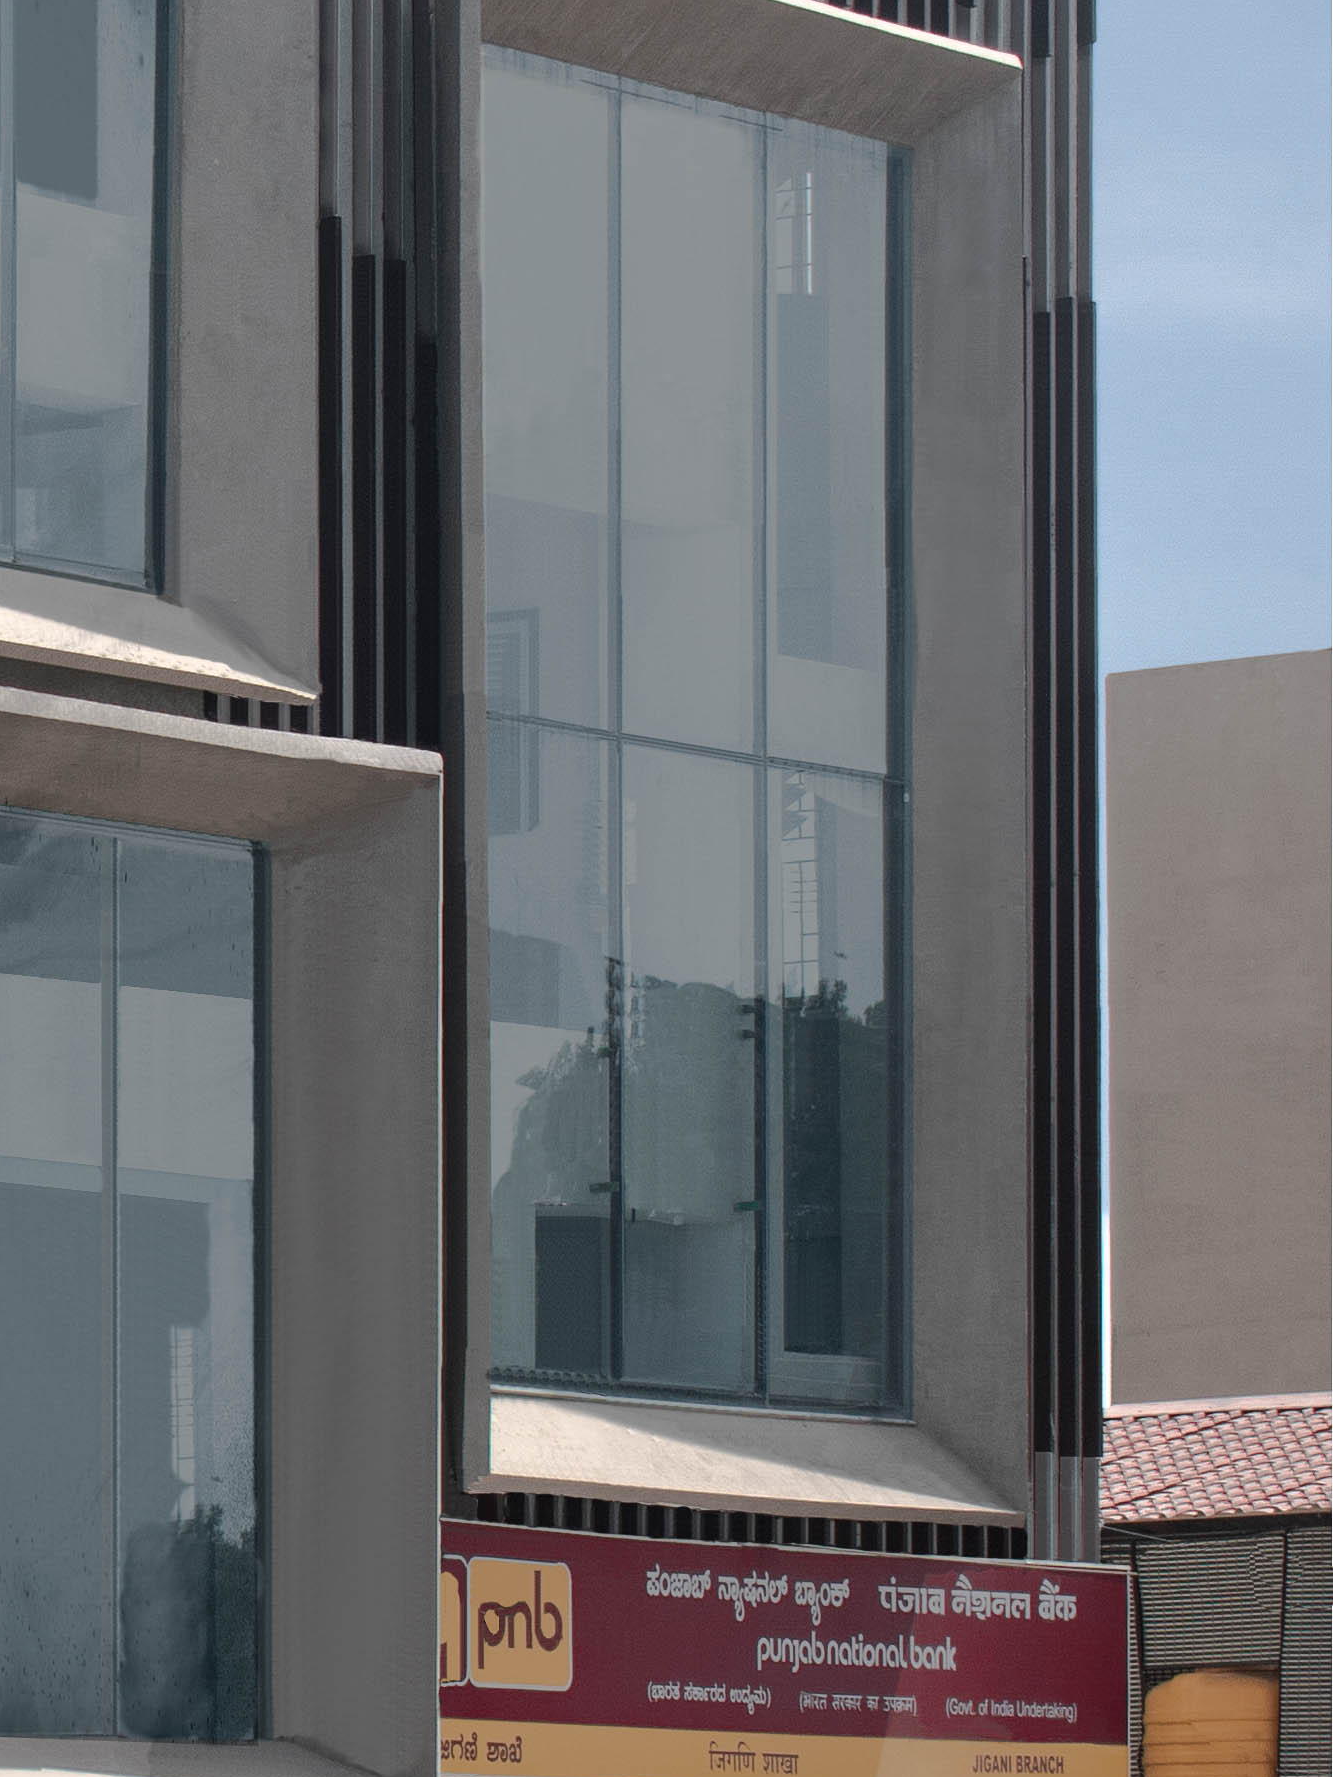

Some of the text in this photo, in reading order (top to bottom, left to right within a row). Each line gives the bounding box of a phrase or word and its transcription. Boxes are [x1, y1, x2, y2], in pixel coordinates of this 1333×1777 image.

[645, 1562, 850, 1626] ಪಂಜಾಬ್ ನ್ಯಾಷನಲ್ ಬ್ಯಾಂಕ್
[877, 1573, 1077, 1621] पंजाब नैशनल बैंक
[477, 1570, 563, 1669] pnb
[756, 1630, 956, 1673] punjab national bank
[978, 1698, 989, 1716] of
[990, 1699, 1015, 1717] India
[1016, 1700, 1078, 1723] Undertaking)
[709, 1740, 799, 1774] जिगणि शाखा
[972, 1754, 1064, 1775] JIGANI BRANCH
